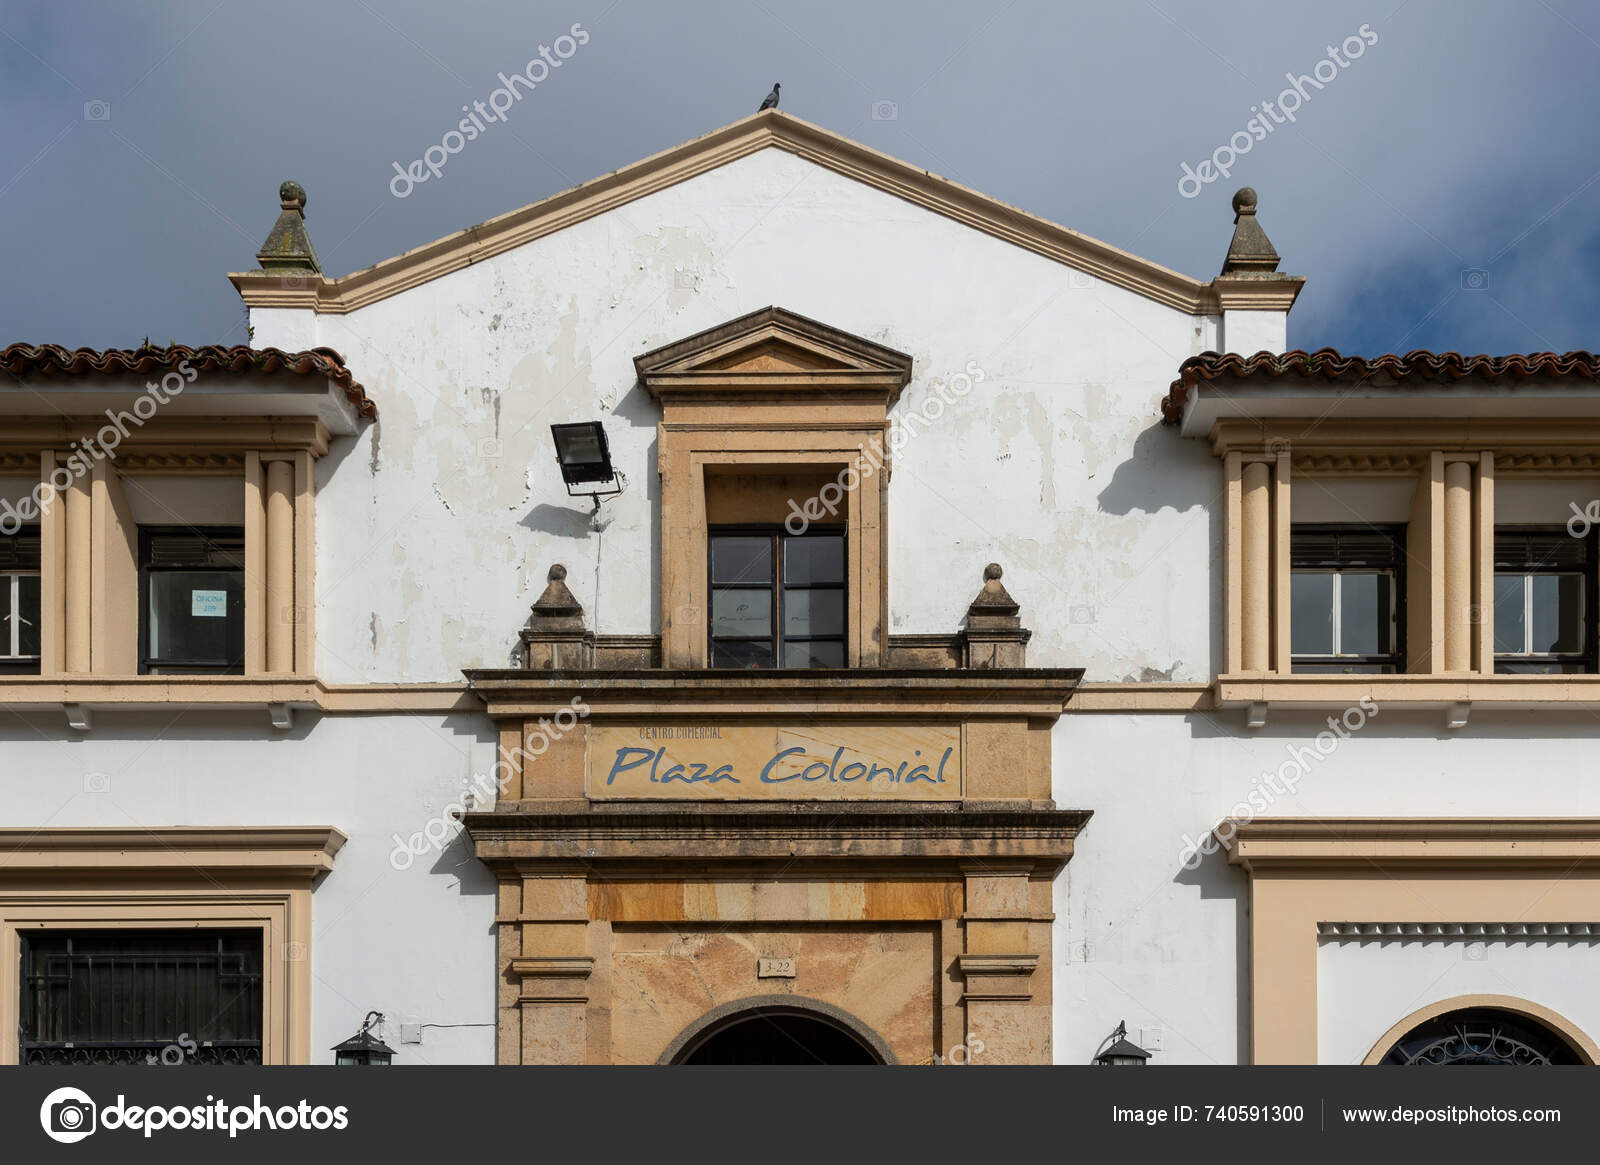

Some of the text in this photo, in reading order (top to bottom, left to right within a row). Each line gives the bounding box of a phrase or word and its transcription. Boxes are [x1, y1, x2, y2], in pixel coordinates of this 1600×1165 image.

[639, 727, 723, 739] CENTRO COMERCIAL
[606, 746, 953, 785] Plaza Colonial
